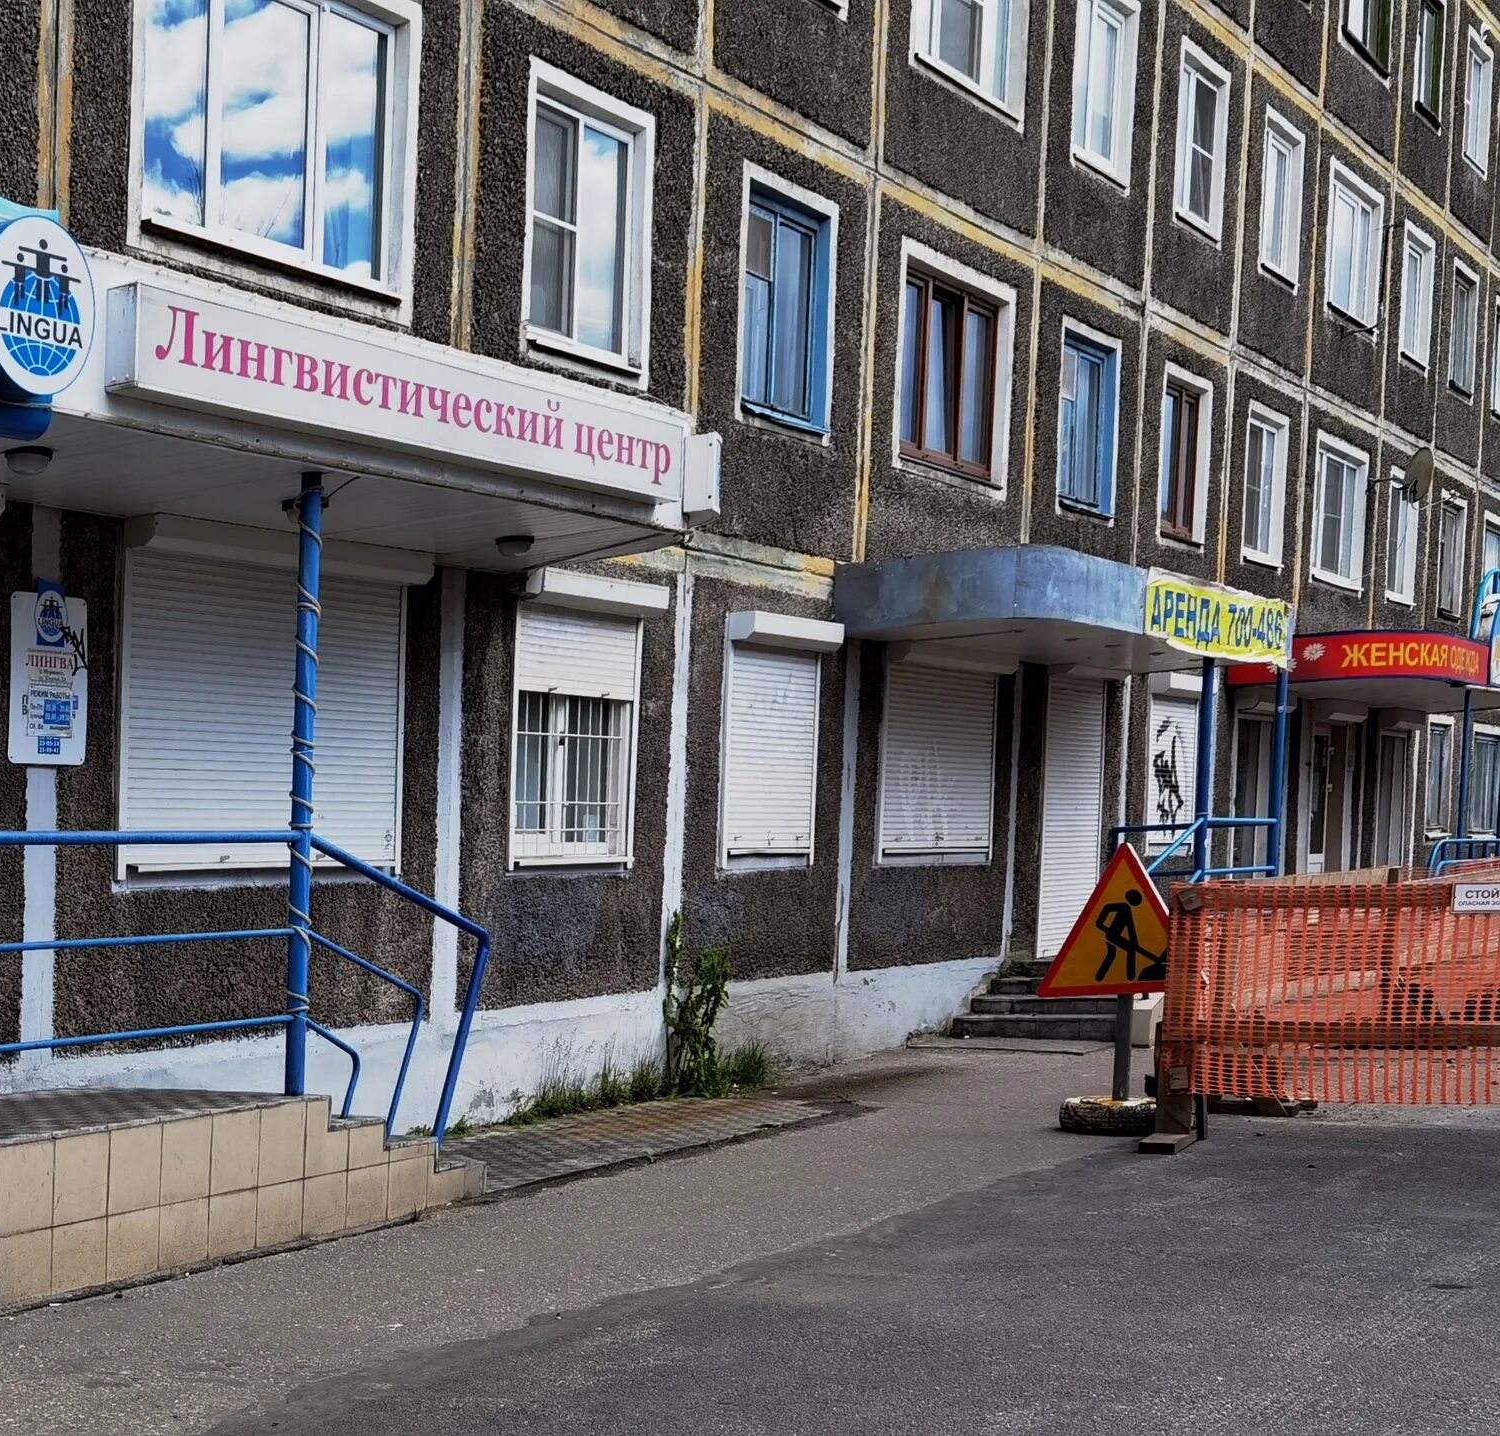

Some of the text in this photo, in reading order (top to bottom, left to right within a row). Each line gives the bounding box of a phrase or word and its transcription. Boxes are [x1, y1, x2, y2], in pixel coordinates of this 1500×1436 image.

[154, 304, 672, 484] Лингвистический центр
[1150, 586, 1284, 650] АРЕНДА 700-486
[25, 654, 74, 670] ЛИНГВА
[1340, 641, 1480, 676] ЖЕНСКАЯ ОДЕЖДА
[1465, 888, 1500, 899] СТОЙ
